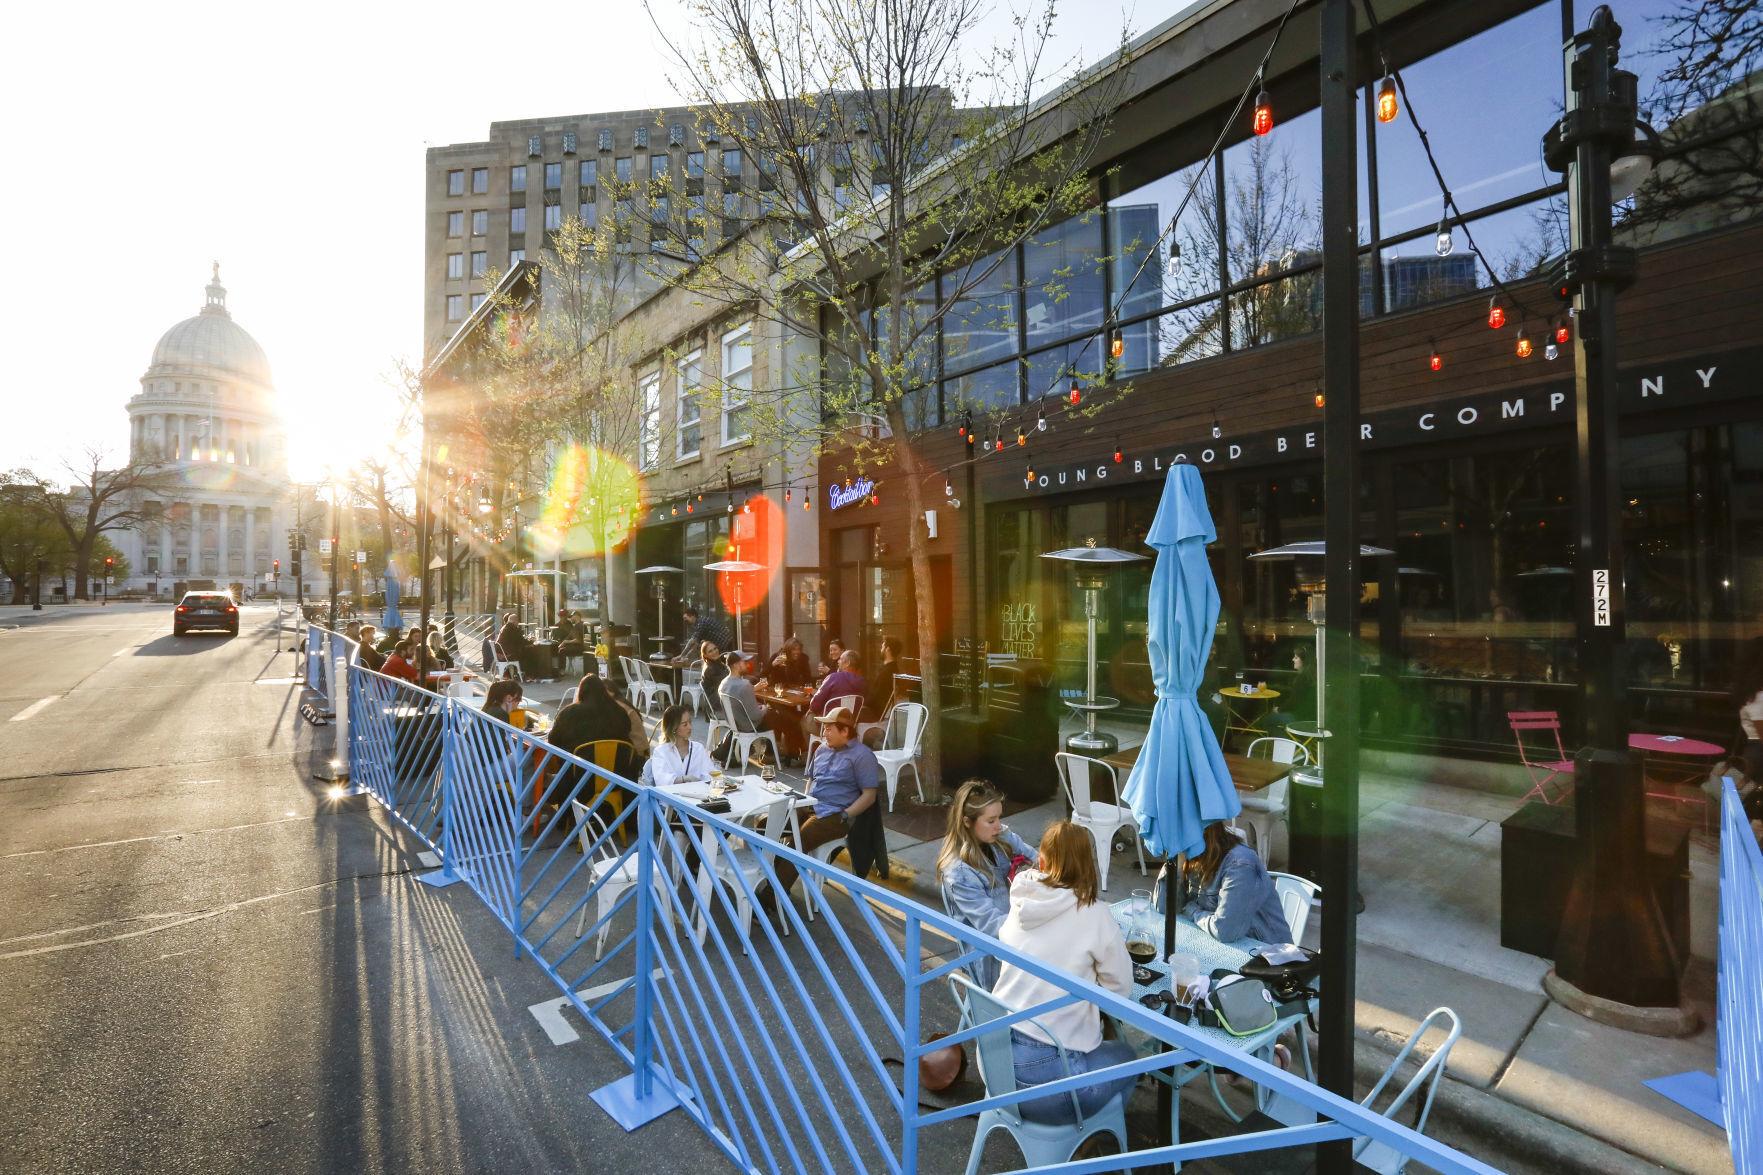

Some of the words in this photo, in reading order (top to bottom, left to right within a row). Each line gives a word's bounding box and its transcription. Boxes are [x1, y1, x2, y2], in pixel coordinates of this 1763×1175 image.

[1023, 466, 1107, 490] YOUNG
[1277, 424, 1373, 453] BER
[1419, 367, 1717, 431] COMPNY
[1002, 603, 1036, 622] BLACK
[1596, 571, 1607, 625] 272M
[1002, 622, 1035, 641] LIVES
